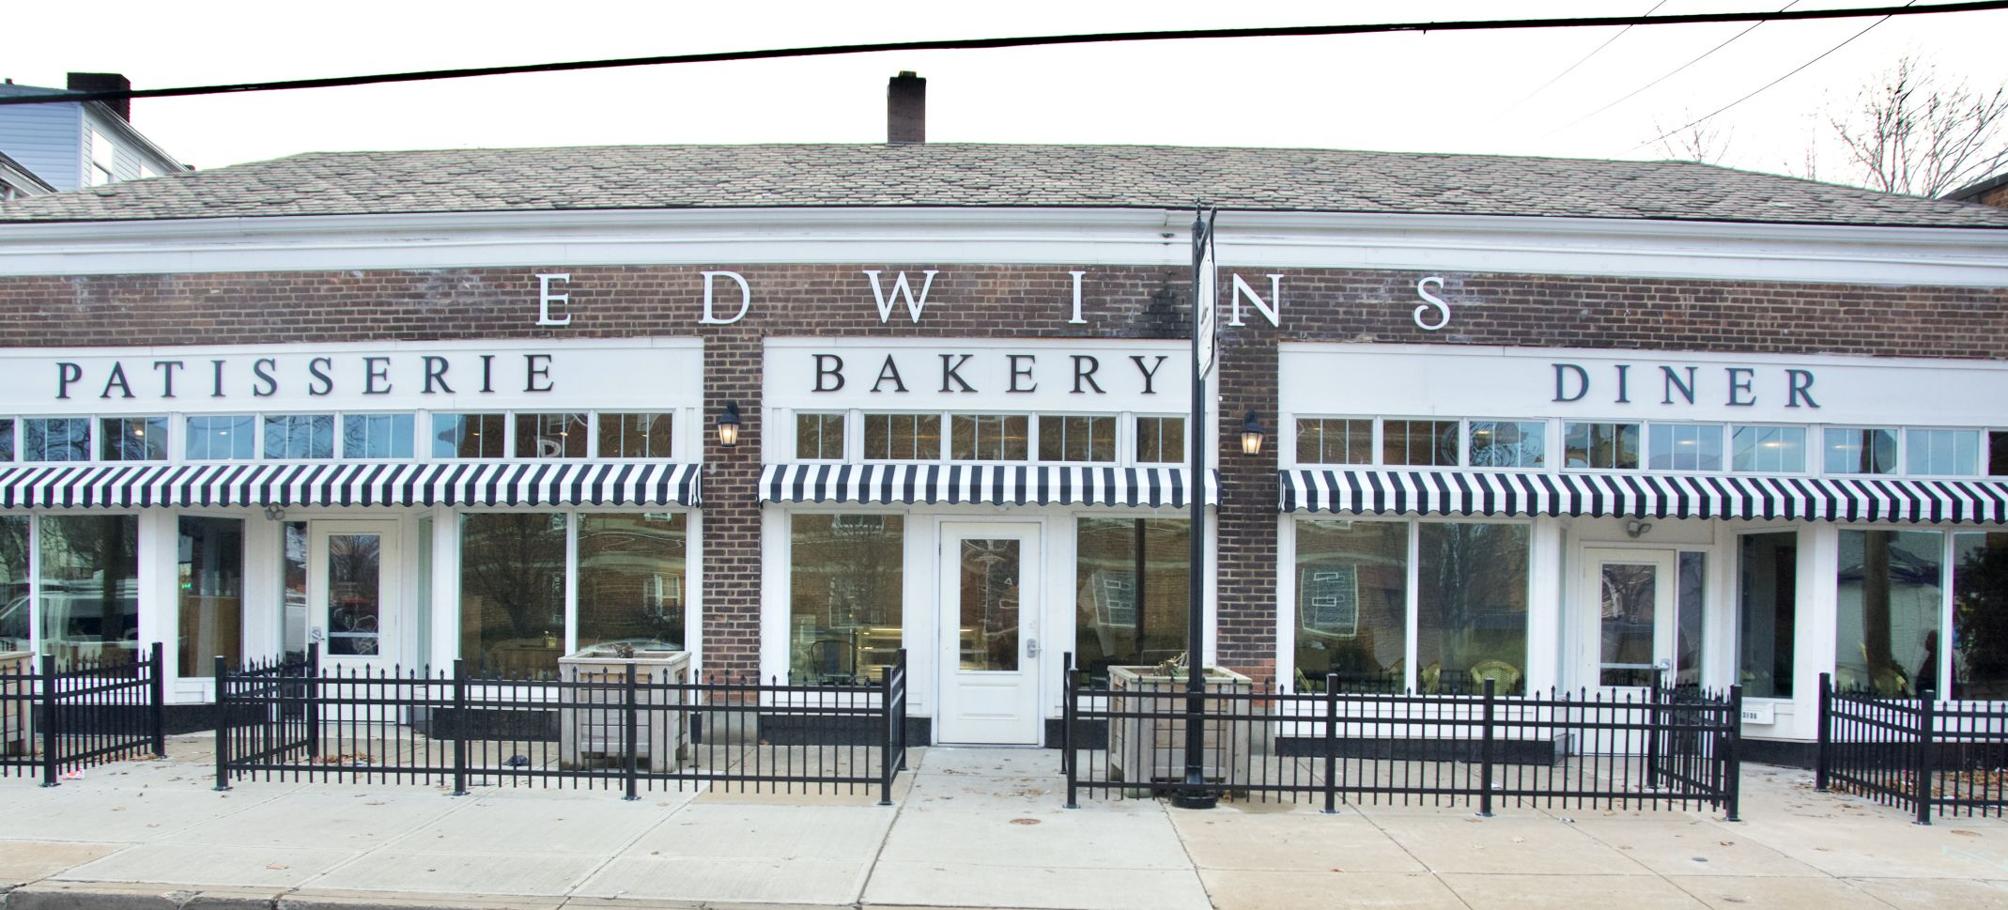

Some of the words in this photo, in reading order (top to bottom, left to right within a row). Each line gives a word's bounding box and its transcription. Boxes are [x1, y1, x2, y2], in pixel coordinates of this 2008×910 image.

[534, 269, 1452, 331] EDWINS
[56, 354, 556, 399] PATISSERIE
[811, 353, 1170, 395] BAKERY
[1551, 362, 1821, 409] DINER
